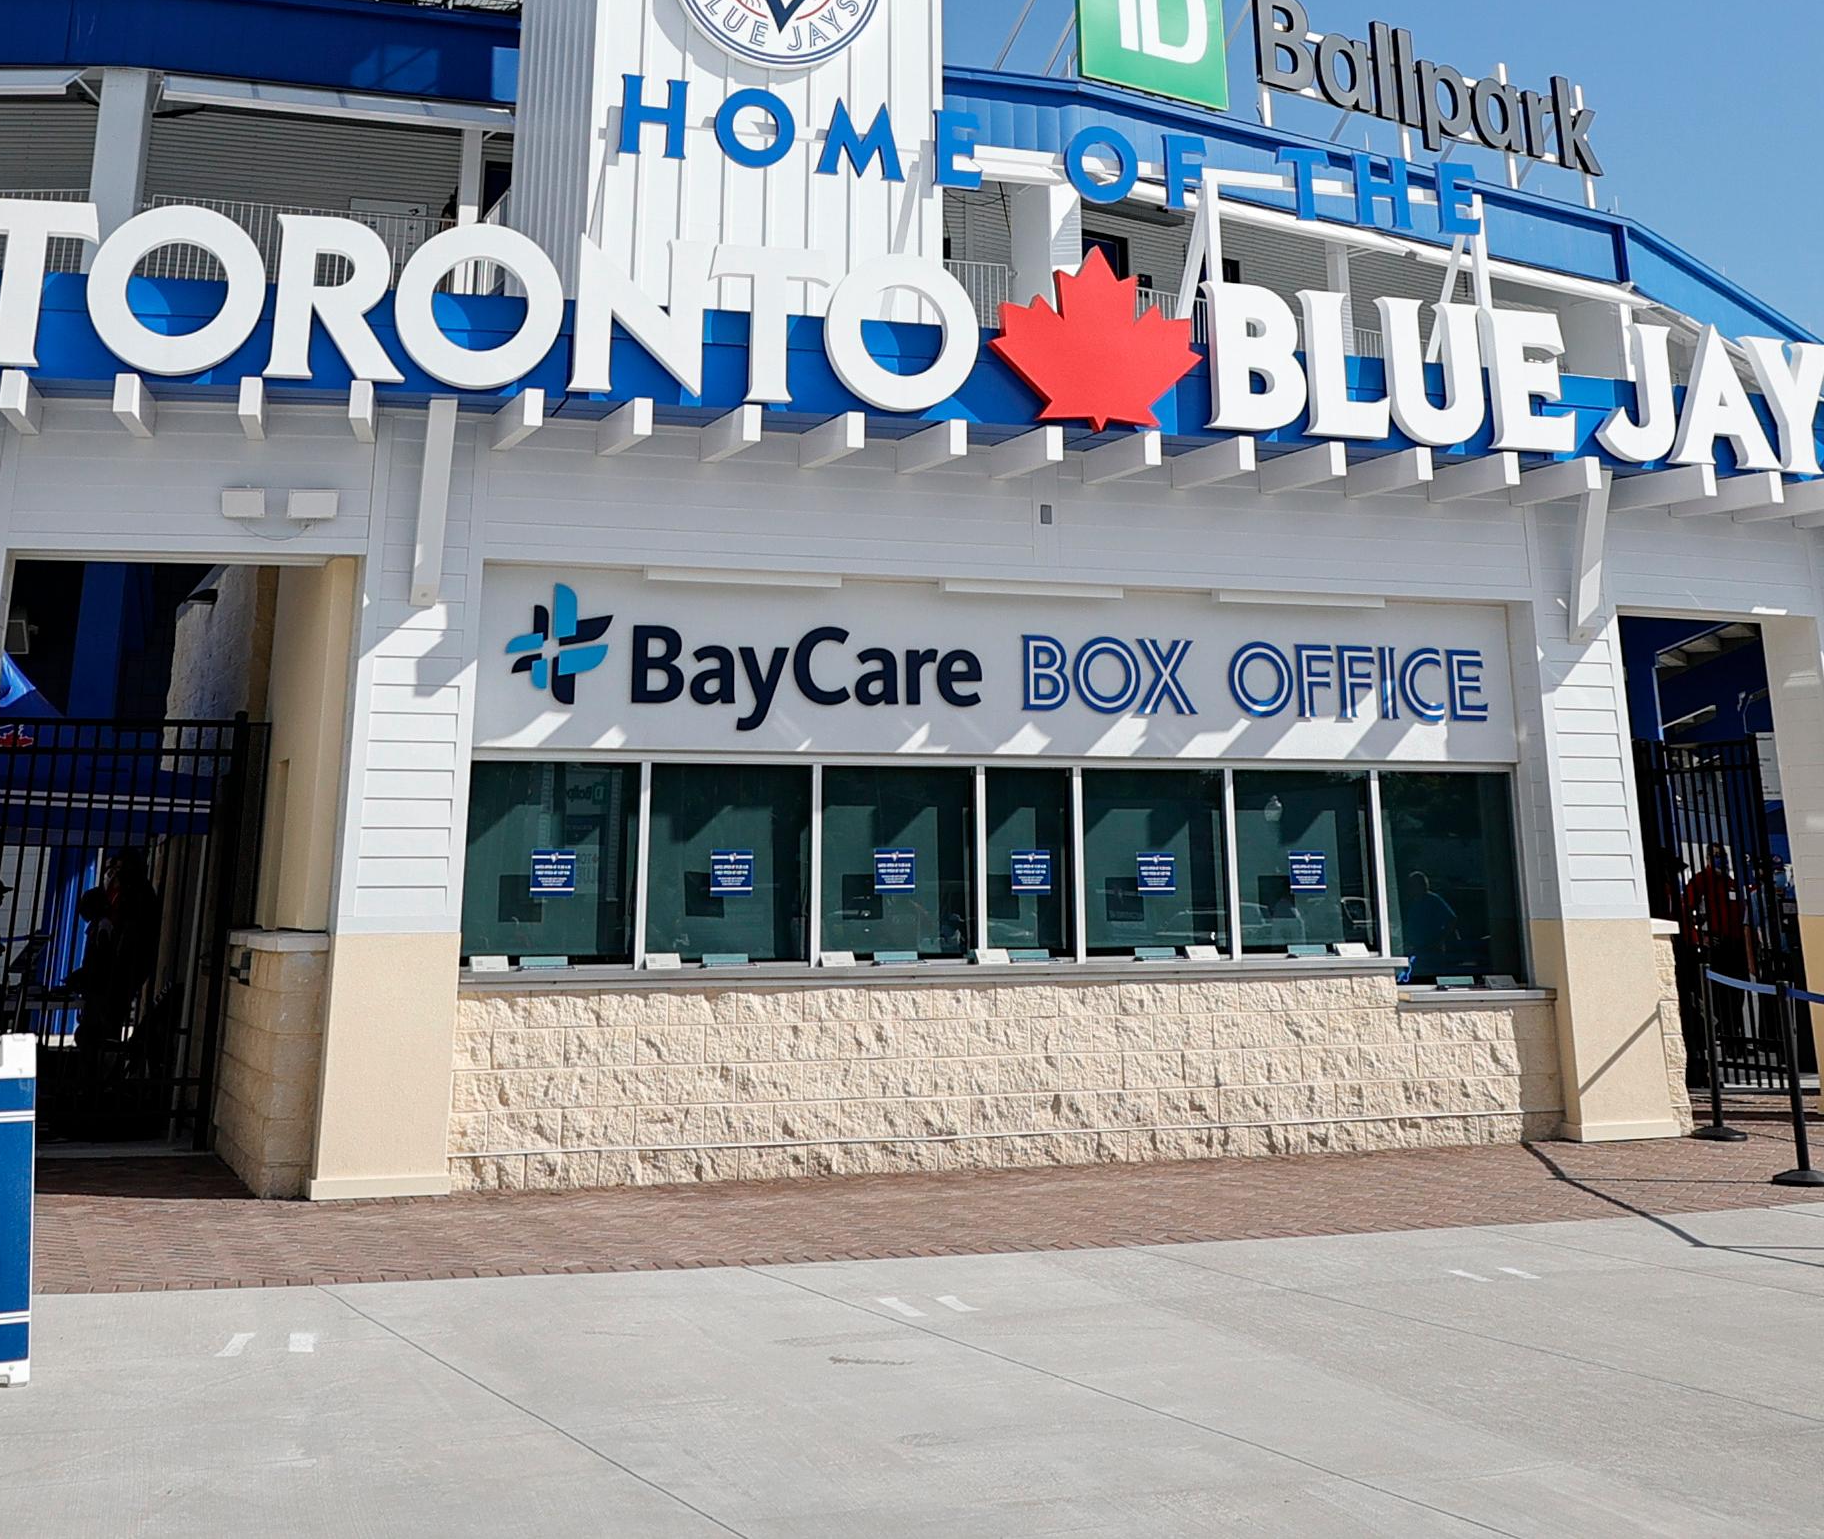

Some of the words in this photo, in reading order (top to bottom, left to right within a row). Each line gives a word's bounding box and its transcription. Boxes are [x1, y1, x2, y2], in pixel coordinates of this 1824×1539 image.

[617, 73, 983, 190] HOME
[1064, 124, 1207, 211] OF
[1276, 146, 1482, 236] THE
[1198, 280, 1577, 454] BLUE
[630, 624, 983, 731] BayCare
[1021, 633, 1199, 716] BOX
[1228, 638, 1489, 722] OFFICE
